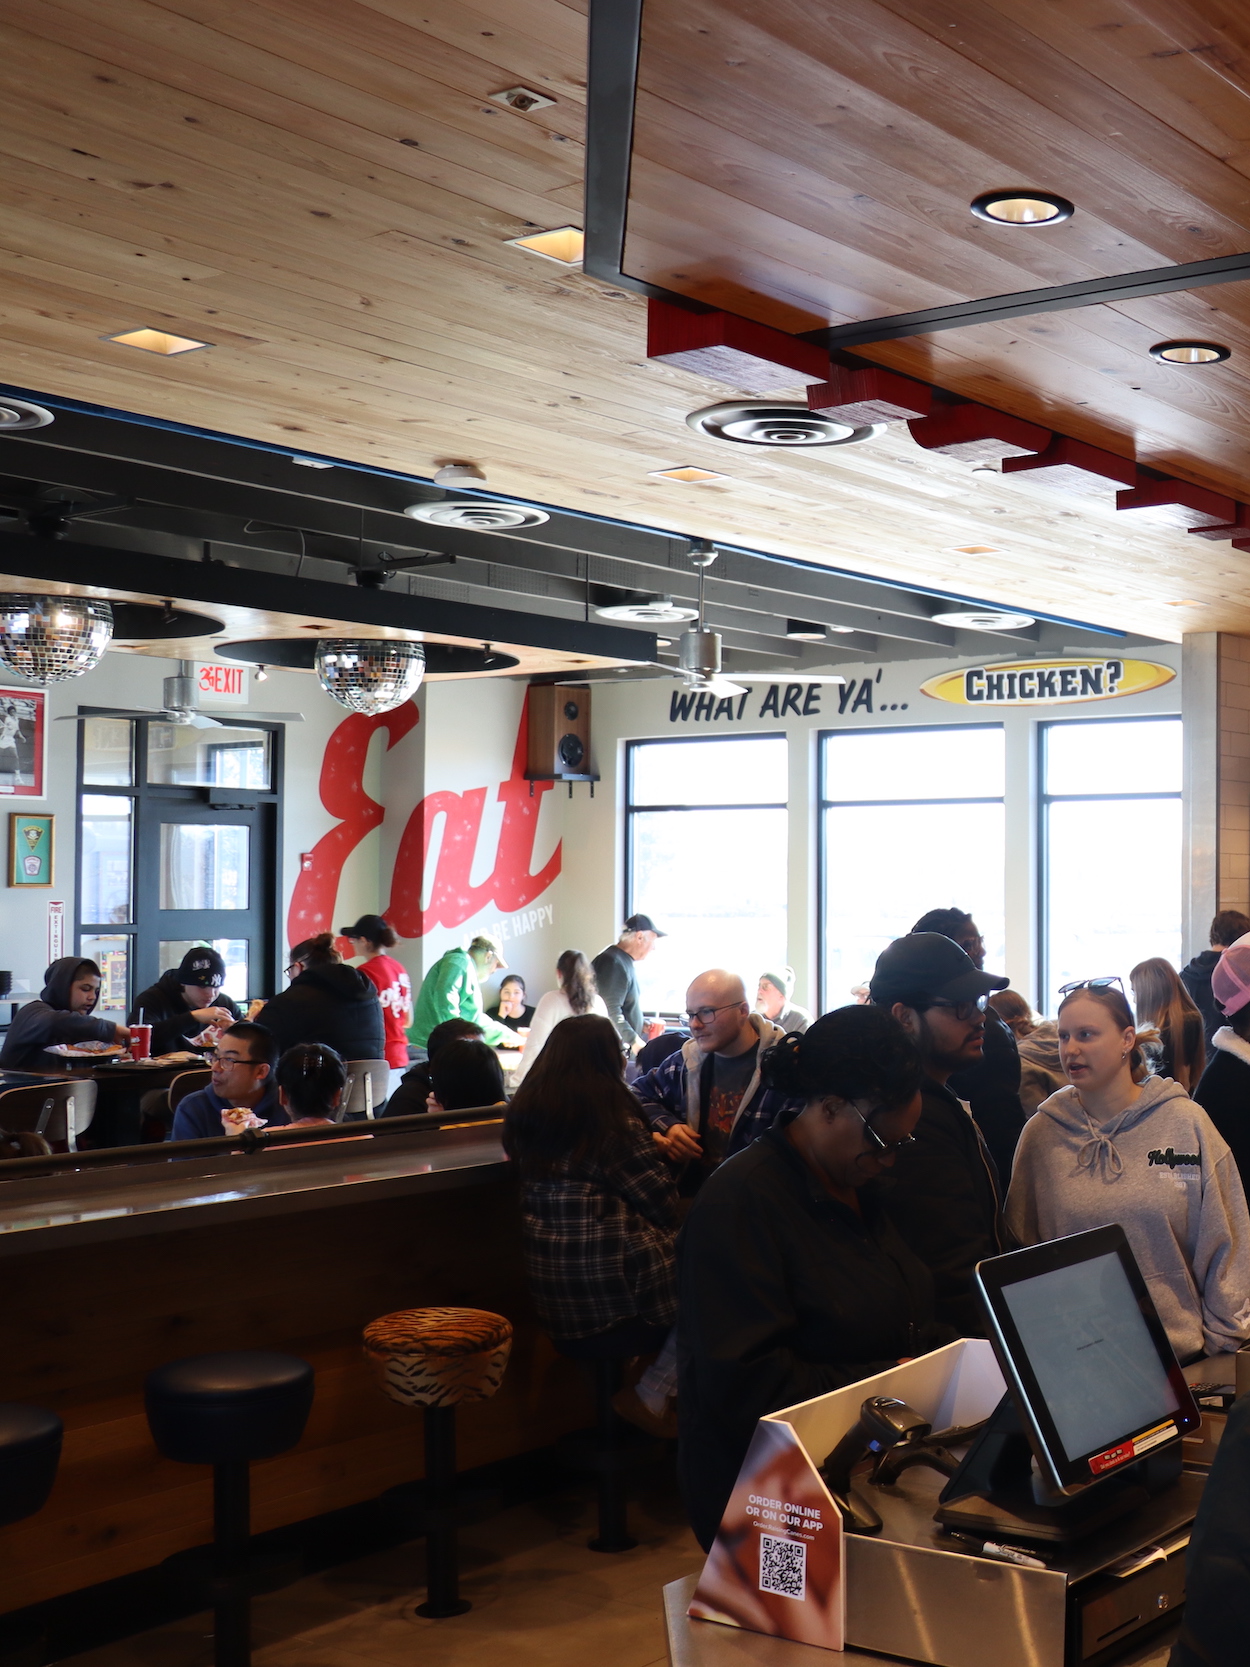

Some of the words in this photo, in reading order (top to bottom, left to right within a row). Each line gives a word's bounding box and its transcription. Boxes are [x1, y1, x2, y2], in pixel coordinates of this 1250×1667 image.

[214, 667, 244, 694] EXIT
[669, 687, 752, 723] WHAT
[758, 683, 823, 718] ARE
[286, 684, 563, 961] Eat
[50, 906, 63, 915] FIRE
[511, 903, 553, 937] HAPPY
[745, 1505, 760, 1517] OR
[761, 1509, 777, 1521] ON
[778, 1513, 801, 1527] OUR
[802, 1518, 823, 1531] APP
[748, 1494, 782, 1510] ORDER
[784, 1502, 821, 1519] ONLINE
[752, 1520, 815, 1541] Order.RaisingCanes.com
